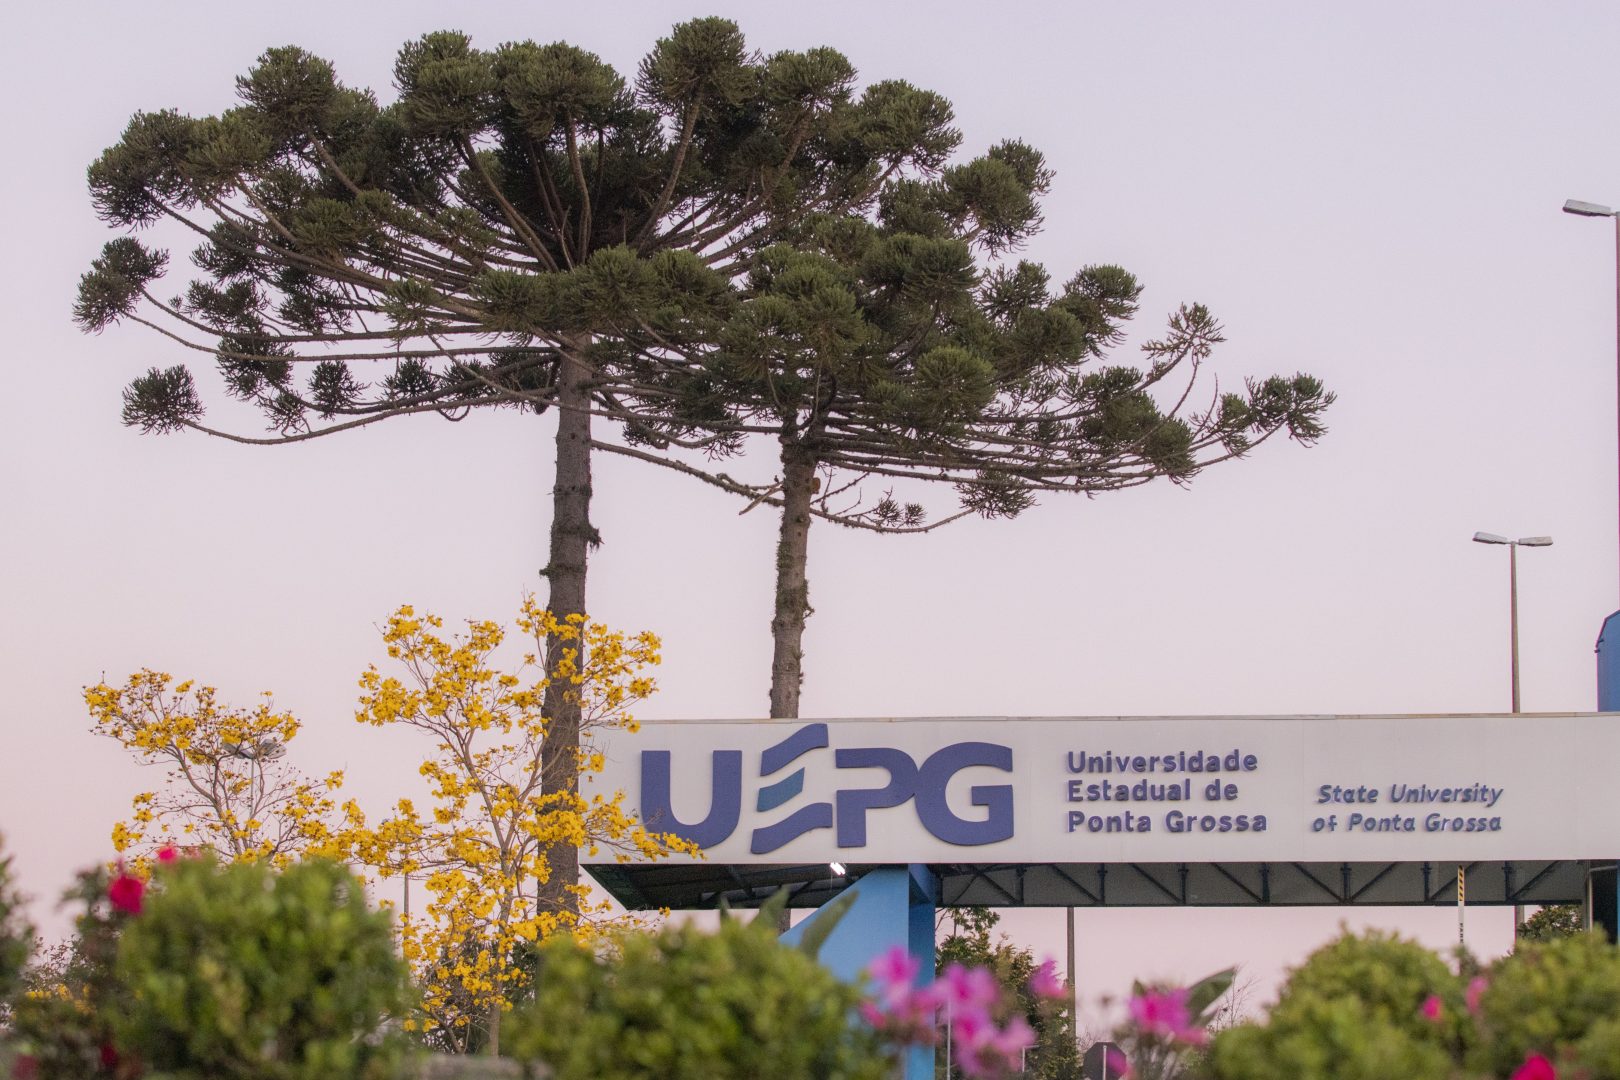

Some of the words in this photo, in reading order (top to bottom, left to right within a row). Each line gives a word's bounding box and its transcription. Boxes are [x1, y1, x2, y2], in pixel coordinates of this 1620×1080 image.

[1066, 749, 1258, 773] Universidade
[641, 723, 1014, 856] UEPG
[1067, 778, 1191, 802] Estadual
[1204, 778, 1239, 802] de
[1317, 784, 1379, 804] State
[1389, 783, 1504, 808] University
[1067, 810, 1152, 833] Ponta
[1166, 810, 1268, 833] Grossa
[1312, 813, 1338, 832] of
[1347, 813, 1416, 832] Ponta
[1424, 813, 1502, 832] Grossa
